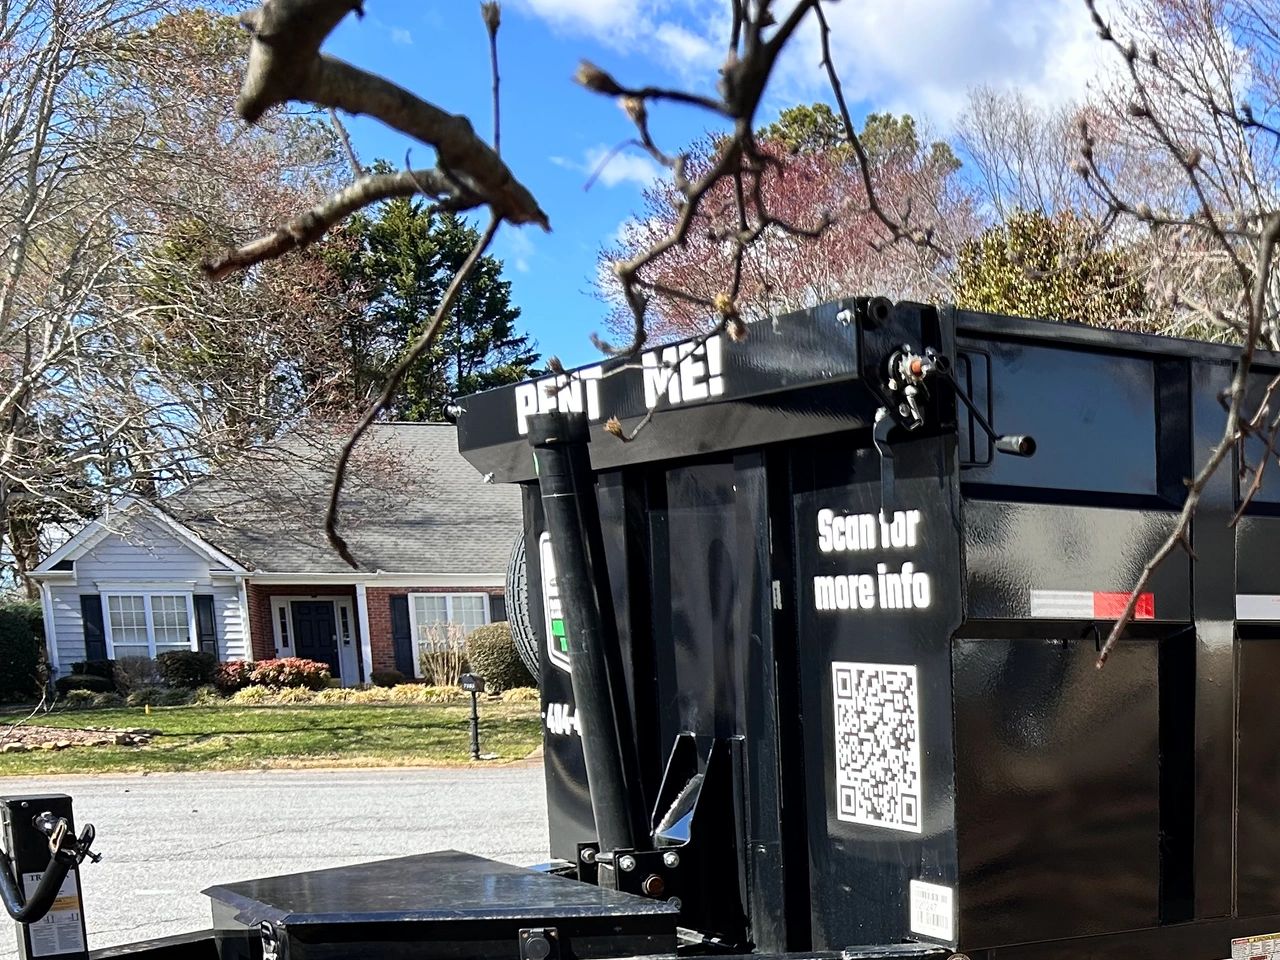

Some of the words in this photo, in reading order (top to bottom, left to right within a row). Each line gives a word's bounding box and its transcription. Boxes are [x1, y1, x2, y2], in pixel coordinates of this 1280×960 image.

[642, 335, 724, 409] ME!
[817, 508, 877, 552] Scan
[878, 507, 921, 549] for
[813, 573, 876, 610] more
[876, 561, 931, 610] info
